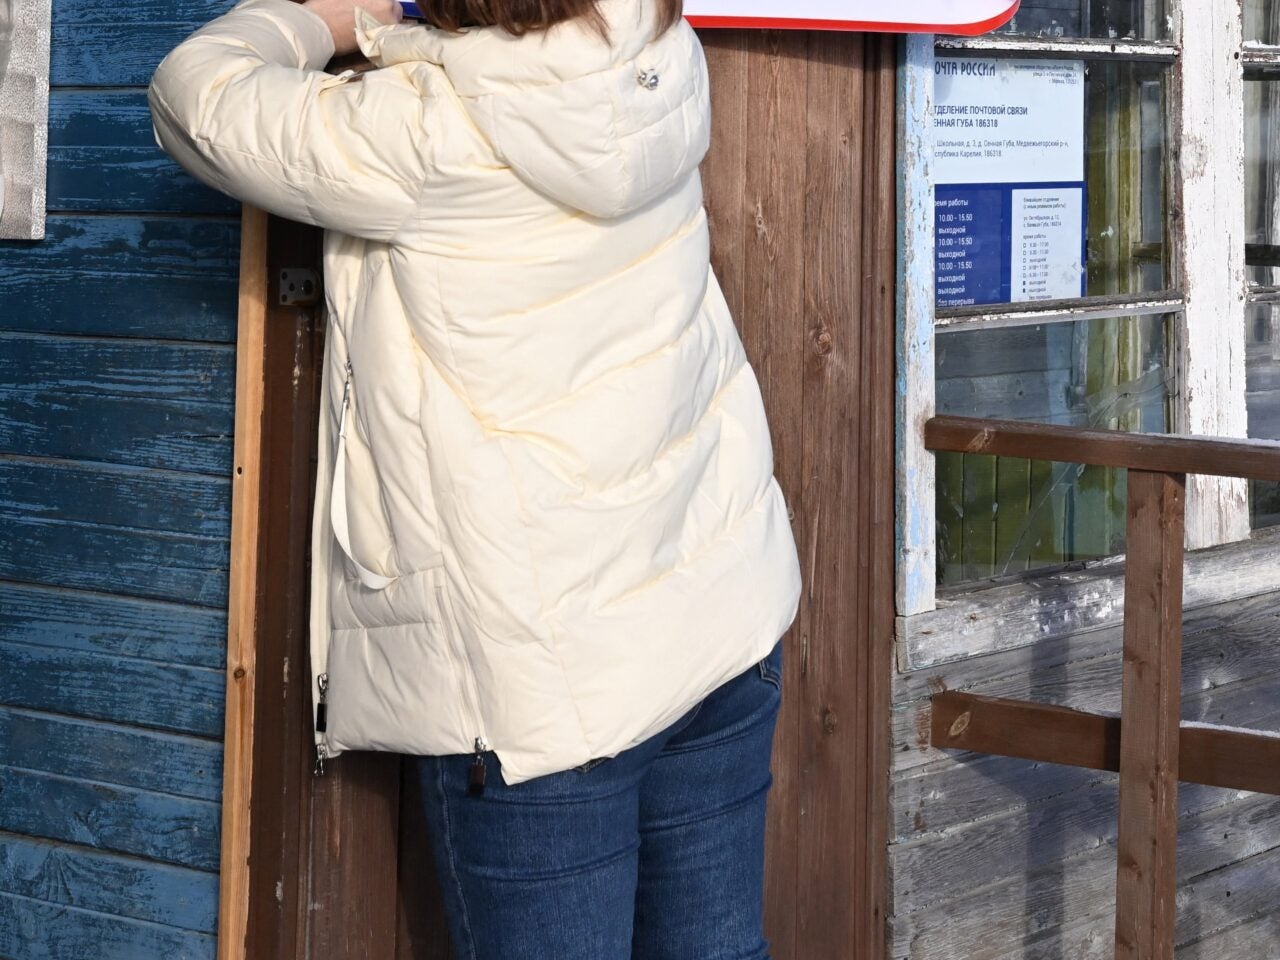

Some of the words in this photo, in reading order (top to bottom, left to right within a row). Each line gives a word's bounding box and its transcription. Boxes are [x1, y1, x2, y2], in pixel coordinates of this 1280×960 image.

[934, 61, 958, 76] ОЧТА
[960, 62, 996, 77] РОССИИ
[934, 105, 969, 116] ТДЕЛЕНИЕ
[969, 104, 1006, 116] ПОЧТОВОЙ
[1007, 106, 1028, 115] СВЯЗИ
[934, 119, 955, 128] ЕННАЯ
[956, 119, 973, 128] ГУБА
[975, 119, 998, 128] 186318
[934, 150, 959, 158] спублика
